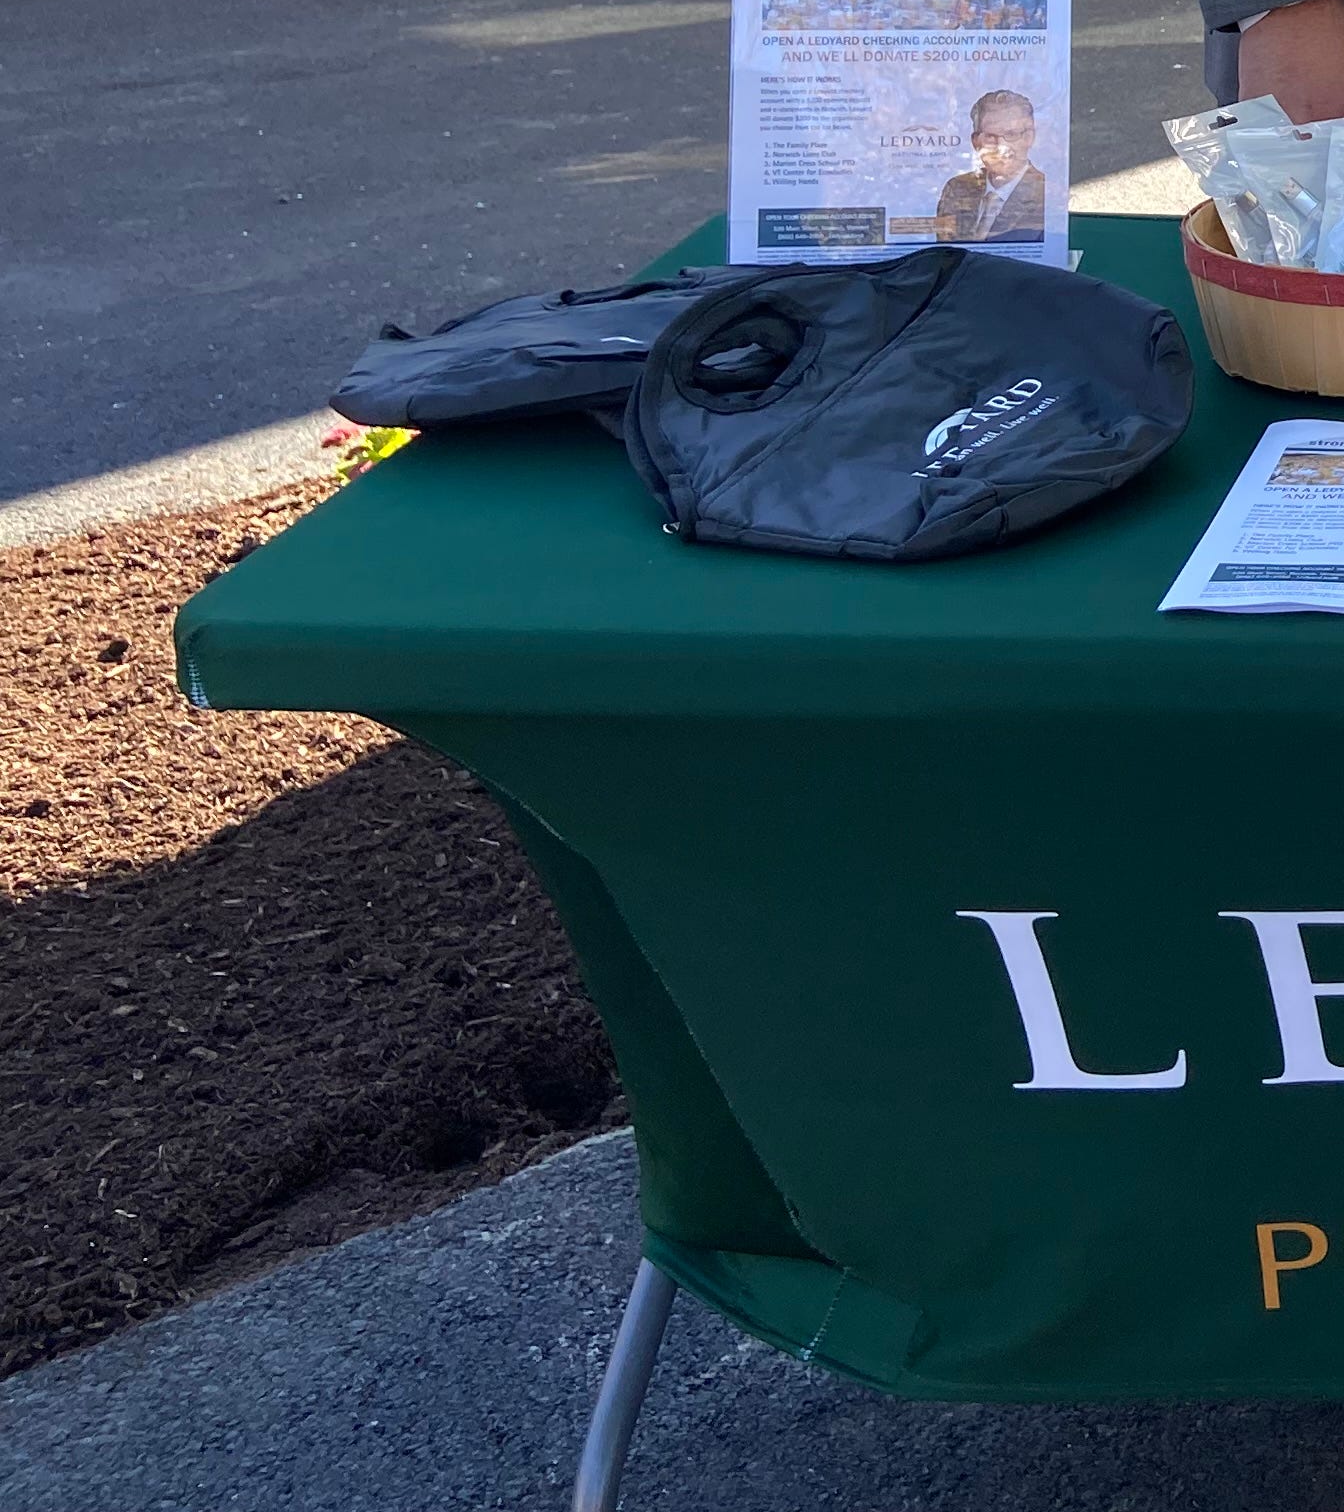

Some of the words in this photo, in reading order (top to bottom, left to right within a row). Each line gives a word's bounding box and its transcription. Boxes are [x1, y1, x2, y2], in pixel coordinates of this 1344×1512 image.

[762, 36, 794, 46] OPEN
[796, 36, 804, 46] A
[808, 36, 860, 46] LEDYARD
[863, 36, 920, 46] CHECKING
[924, 36, 975, 46] ACCOUNT
[978, 36, 989, 46] IN
[993, 35, 1046, 45] NORWICH
[781, 51, 811, 63] AND
[817, 51, 859, 63] WE'LL
[863, 51, 918, 62] DONATE
[923, 50, 960, 62] $200
[880, 135, 962, 148] LEDYARD
[971, 430, 1005, 447] well.
[1000, 414, 1030, 430] Live
[1029, 395, 1060, 416] well.
